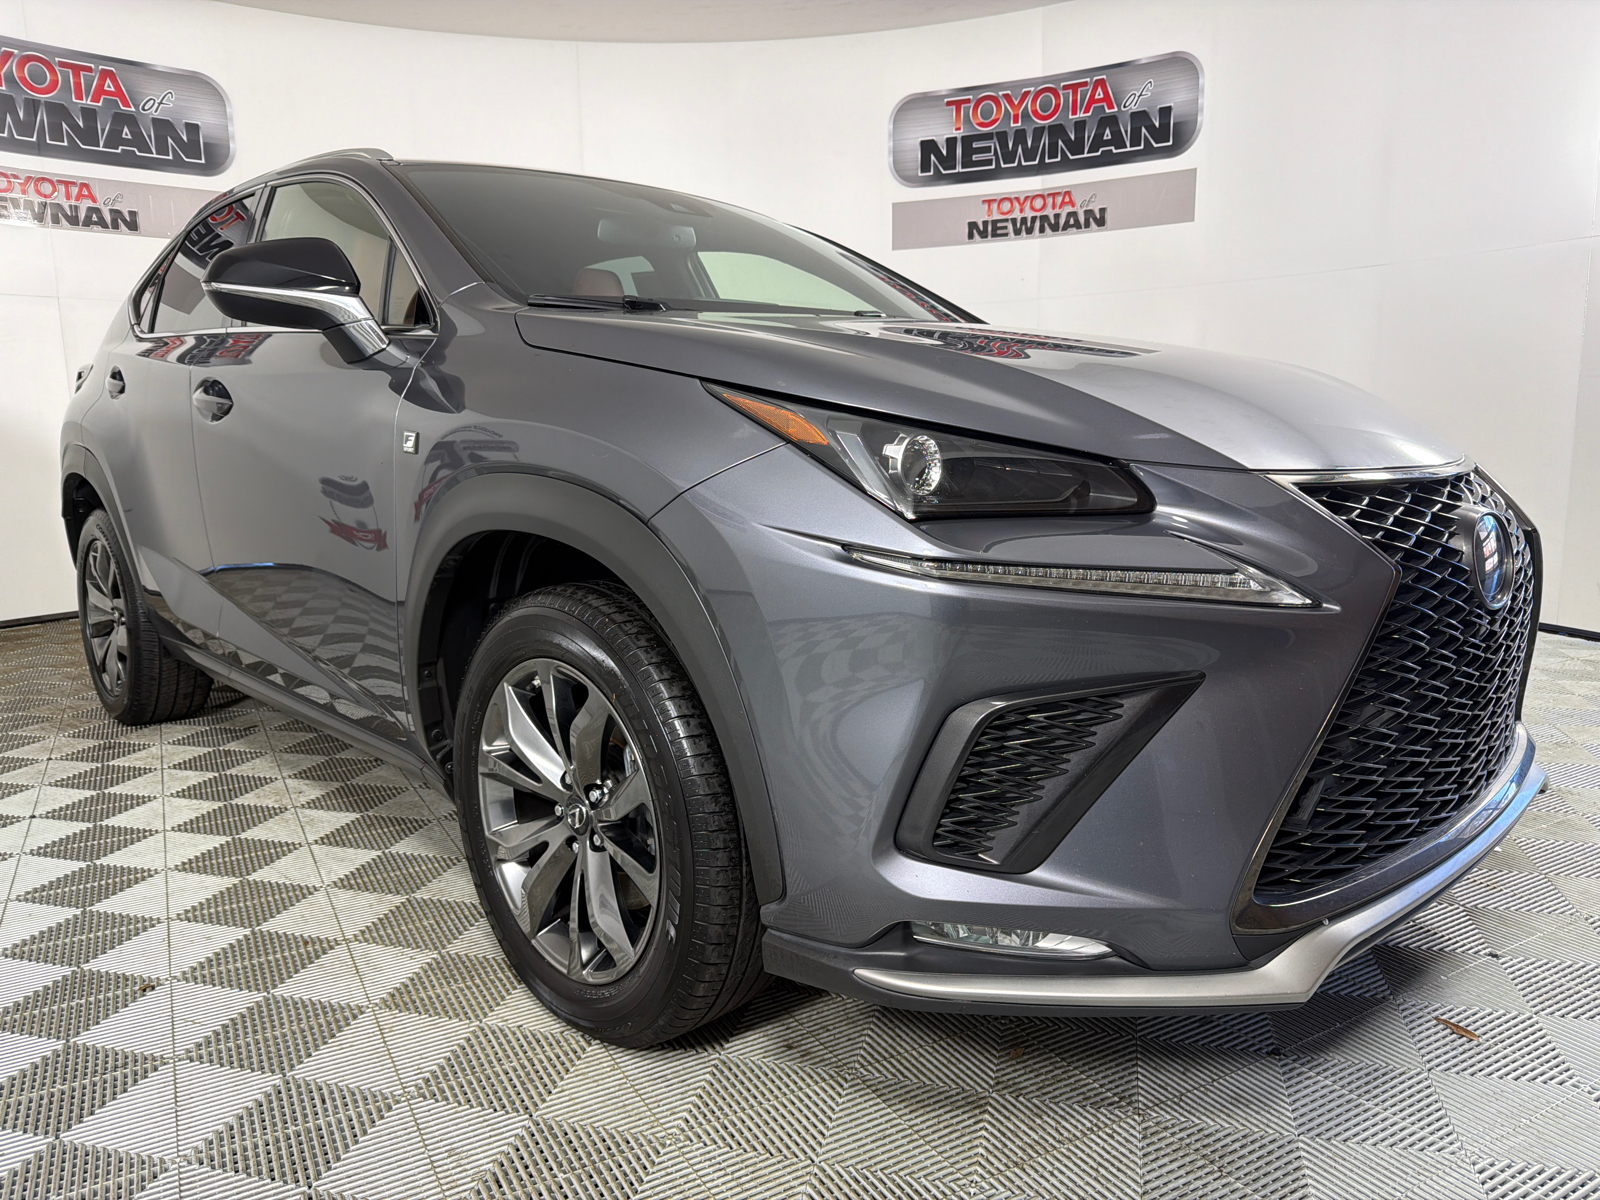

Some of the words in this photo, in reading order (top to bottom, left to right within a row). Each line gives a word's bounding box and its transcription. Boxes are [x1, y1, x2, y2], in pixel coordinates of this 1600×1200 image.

[140, 90, 174, 114] of
[945, 76, 1117, 132] TOYOTA
[1122, 79, 1154, 110] of
[918, 105, 1174, 175] NEWNAN
[102, 192, 124, 207] of
[982, 190, 1075, 217] TOYOTA
[1079, 193, 1097, 208] of
[967, 207, 1107, 240] NEWNAN
